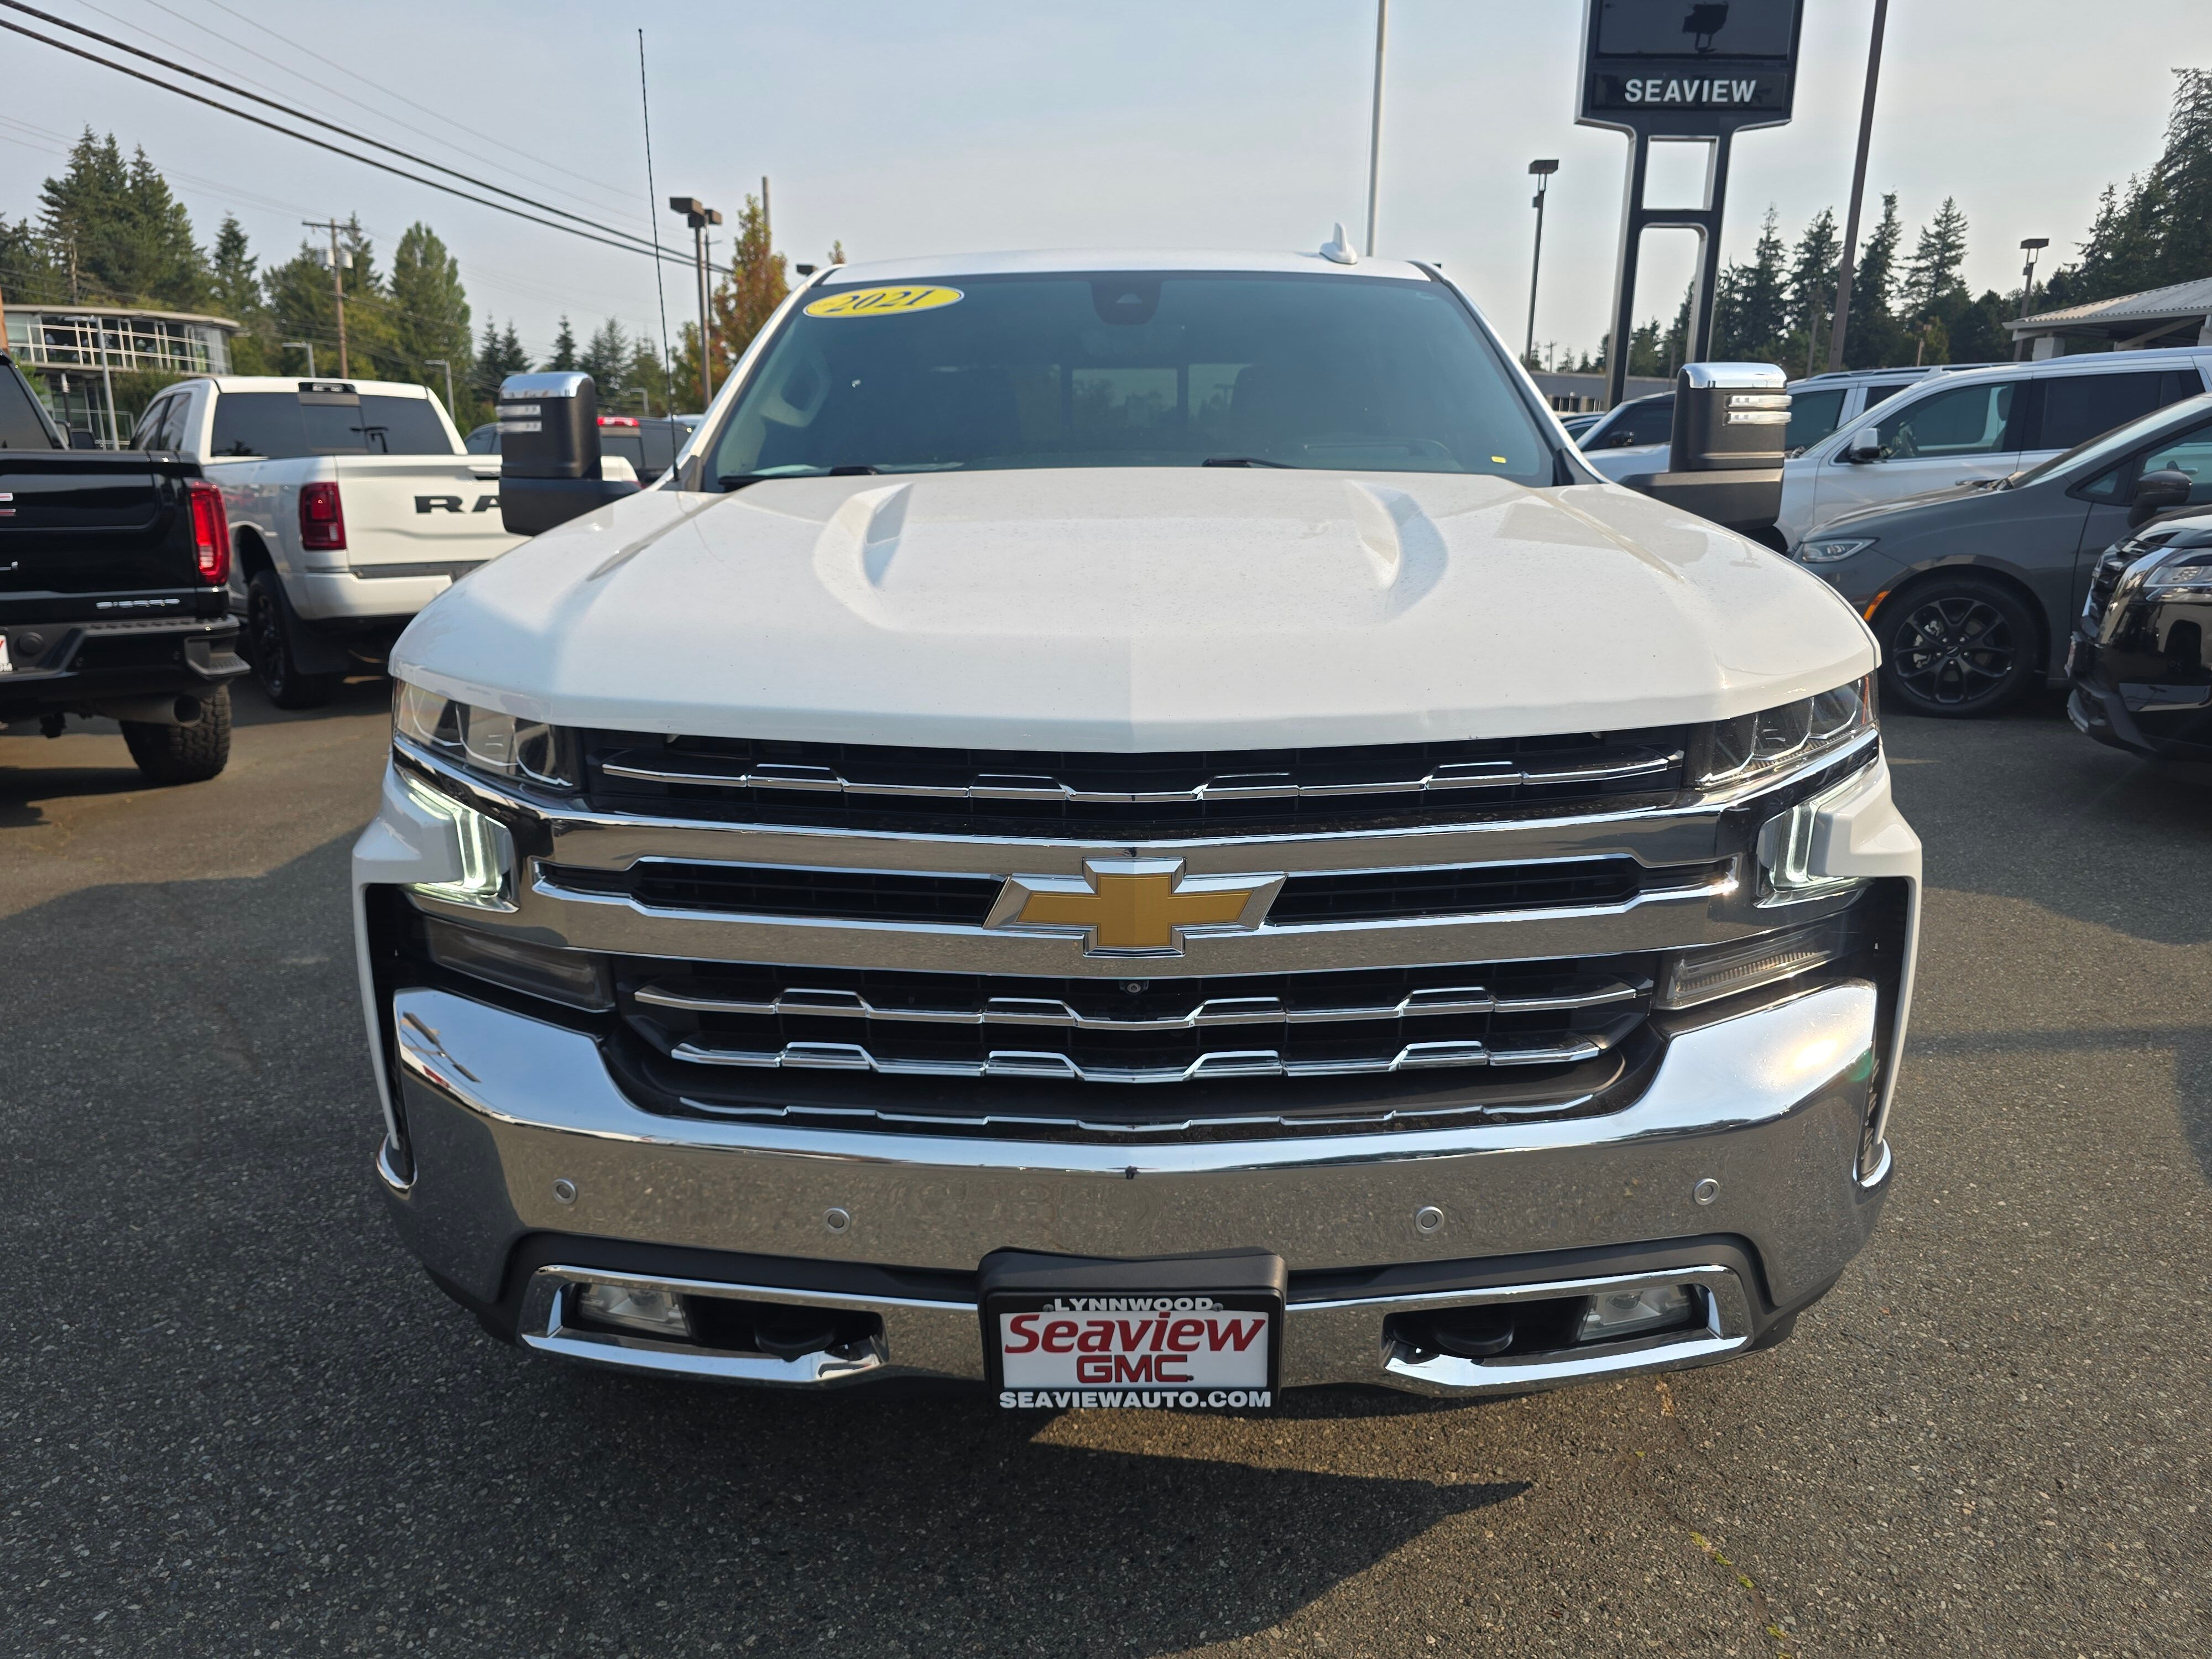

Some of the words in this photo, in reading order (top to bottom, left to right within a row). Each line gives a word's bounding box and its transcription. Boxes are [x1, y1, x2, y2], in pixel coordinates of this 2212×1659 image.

[1624, 78, 1757, 103] SEAVIEW
[823, 289, 936, 313] 2021
[414, 495, 502, 514] RA
[1053, 1297, 1214, 1312] LYNNWOOD
[1004, 1311, 1266, 1353] Seaview
[1077, 1354, 1188, 1383] GMC
[999, 1390, 1271, 1408] SEAVIEWAUTO.COM
